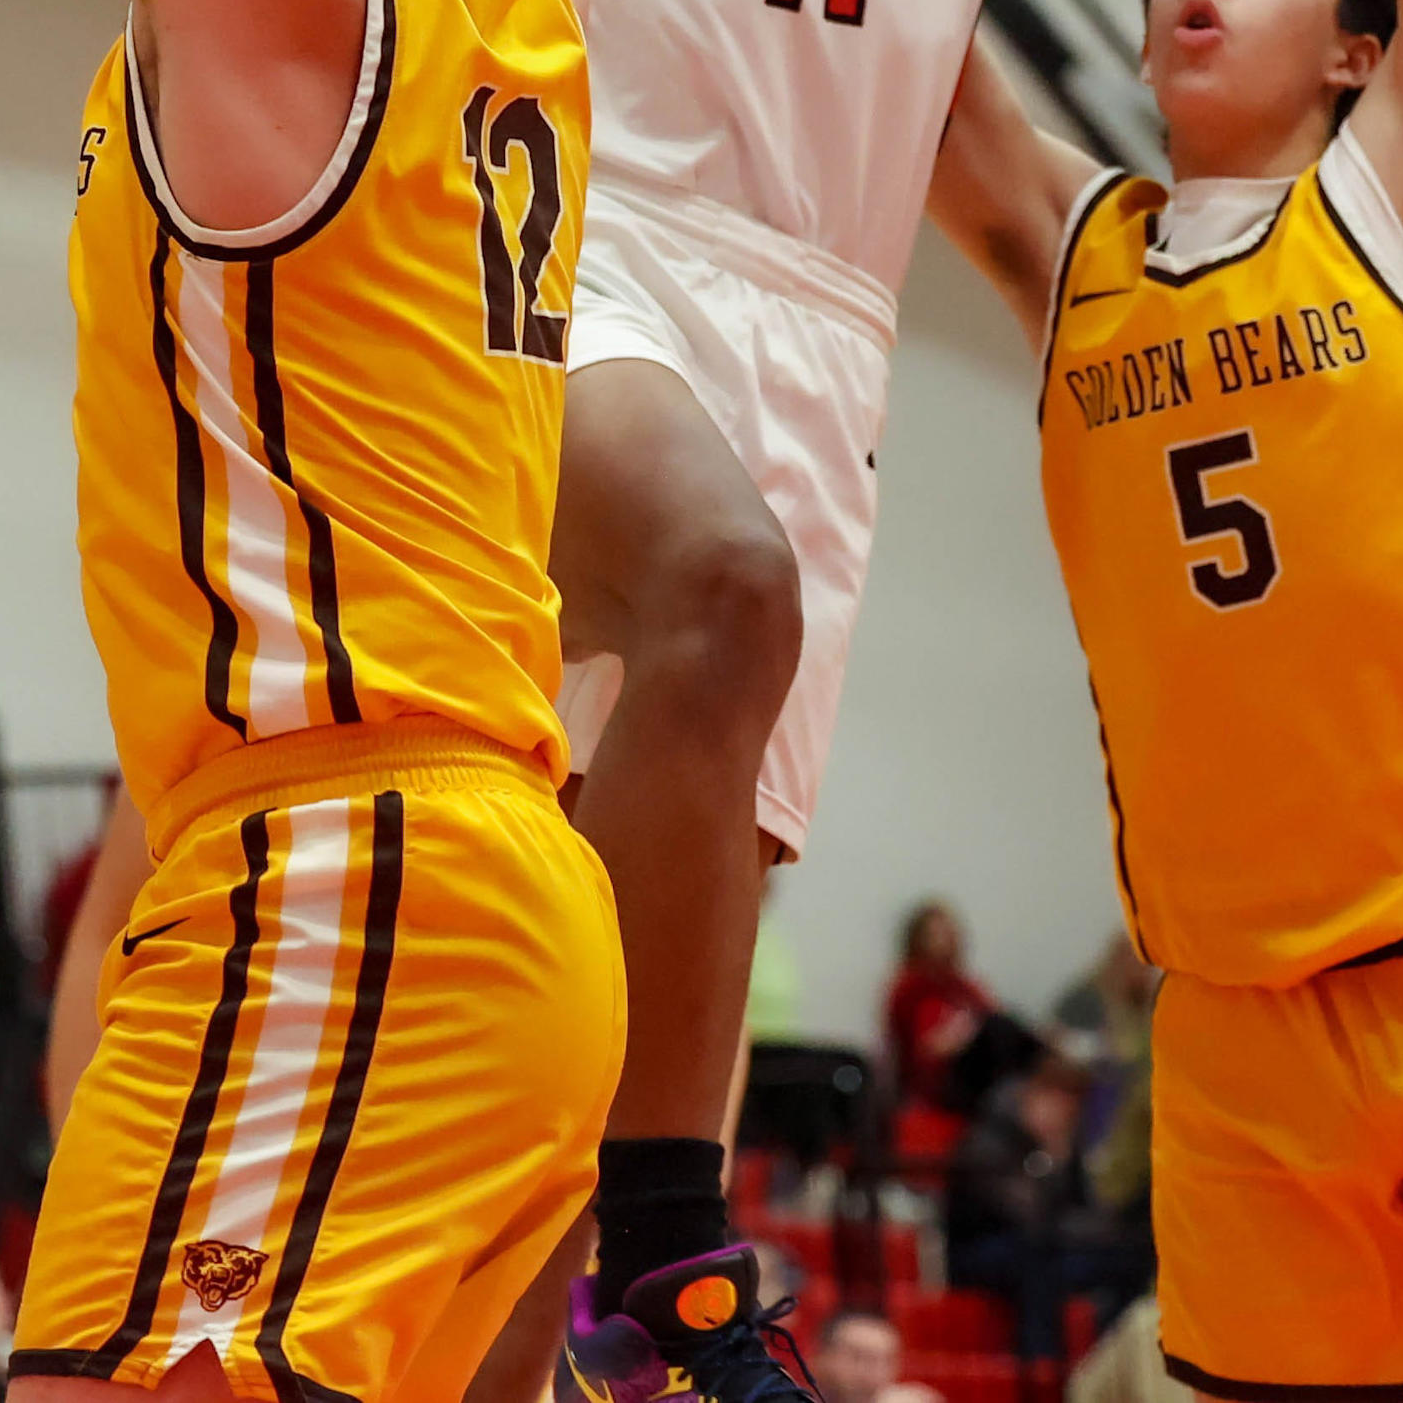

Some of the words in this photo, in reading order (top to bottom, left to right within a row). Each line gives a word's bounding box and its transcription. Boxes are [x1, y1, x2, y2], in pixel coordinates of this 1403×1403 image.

[462, 84, 567, 368] 12
[1065, 338, 1193, 431] GOLDEN
[1209, 300, 1368, 395] BEARS
[1165, 428, 1283, 613] 5
